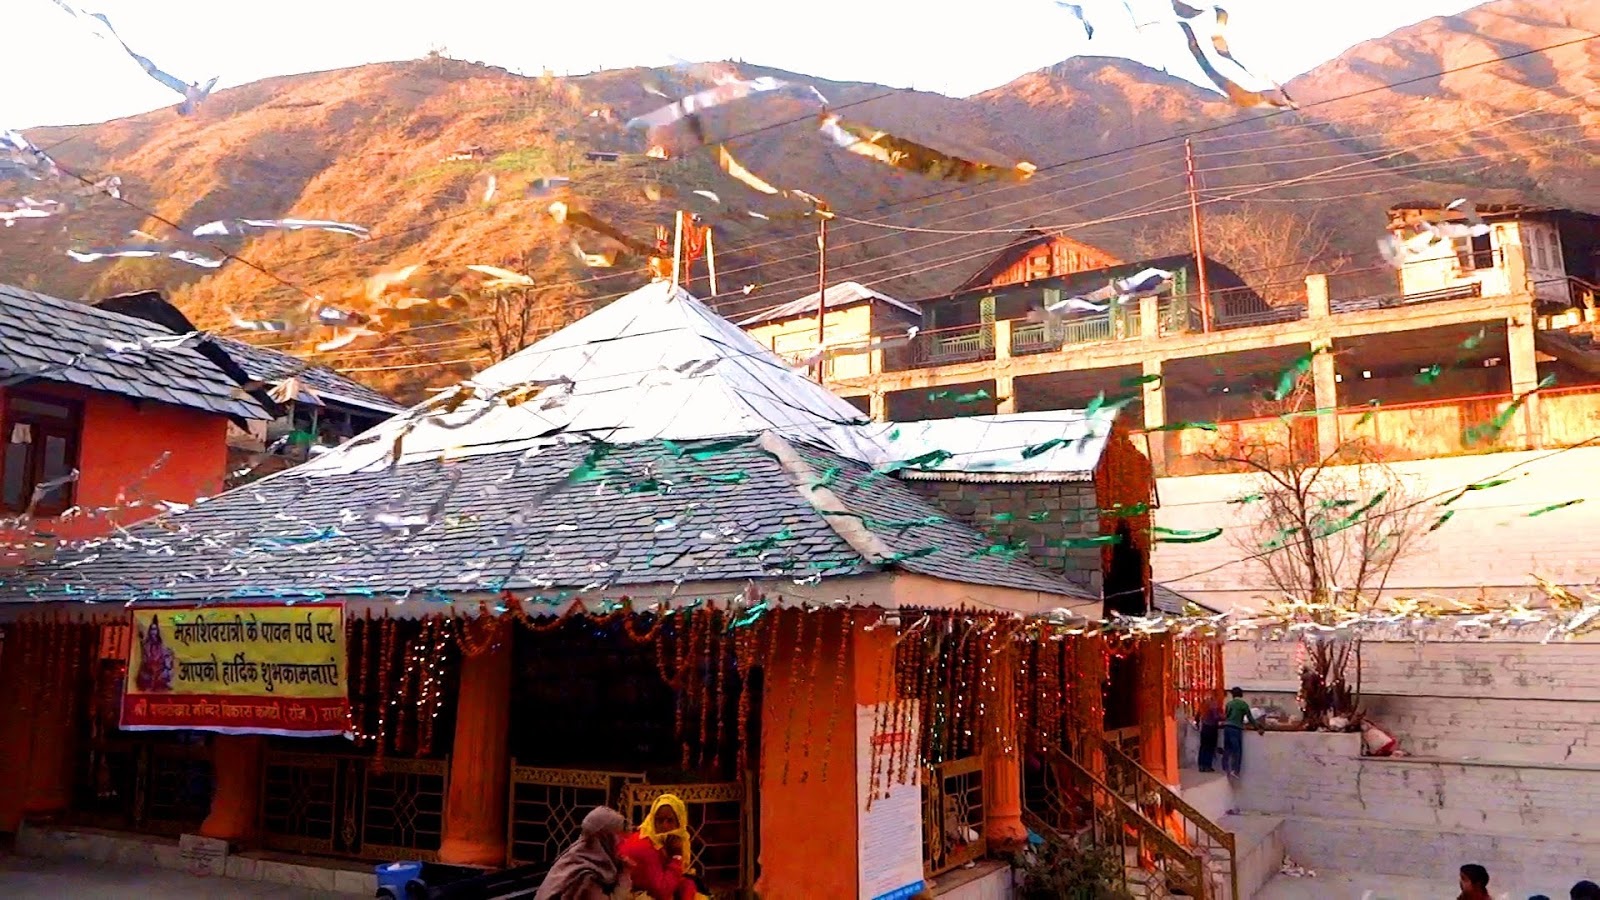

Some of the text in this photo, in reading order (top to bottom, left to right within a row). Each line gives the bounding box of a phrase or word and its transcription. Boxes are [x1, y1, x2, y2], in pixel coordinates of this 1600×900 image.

[246, 612, 258, 643] के
[261, 622, 291, 643] पावन
[295, 612, 313, 643] पर्व
[316, 622, 336, 643] पर
[178, 651, 338, 691] आपको हार्दिक शुभकामनाएं
